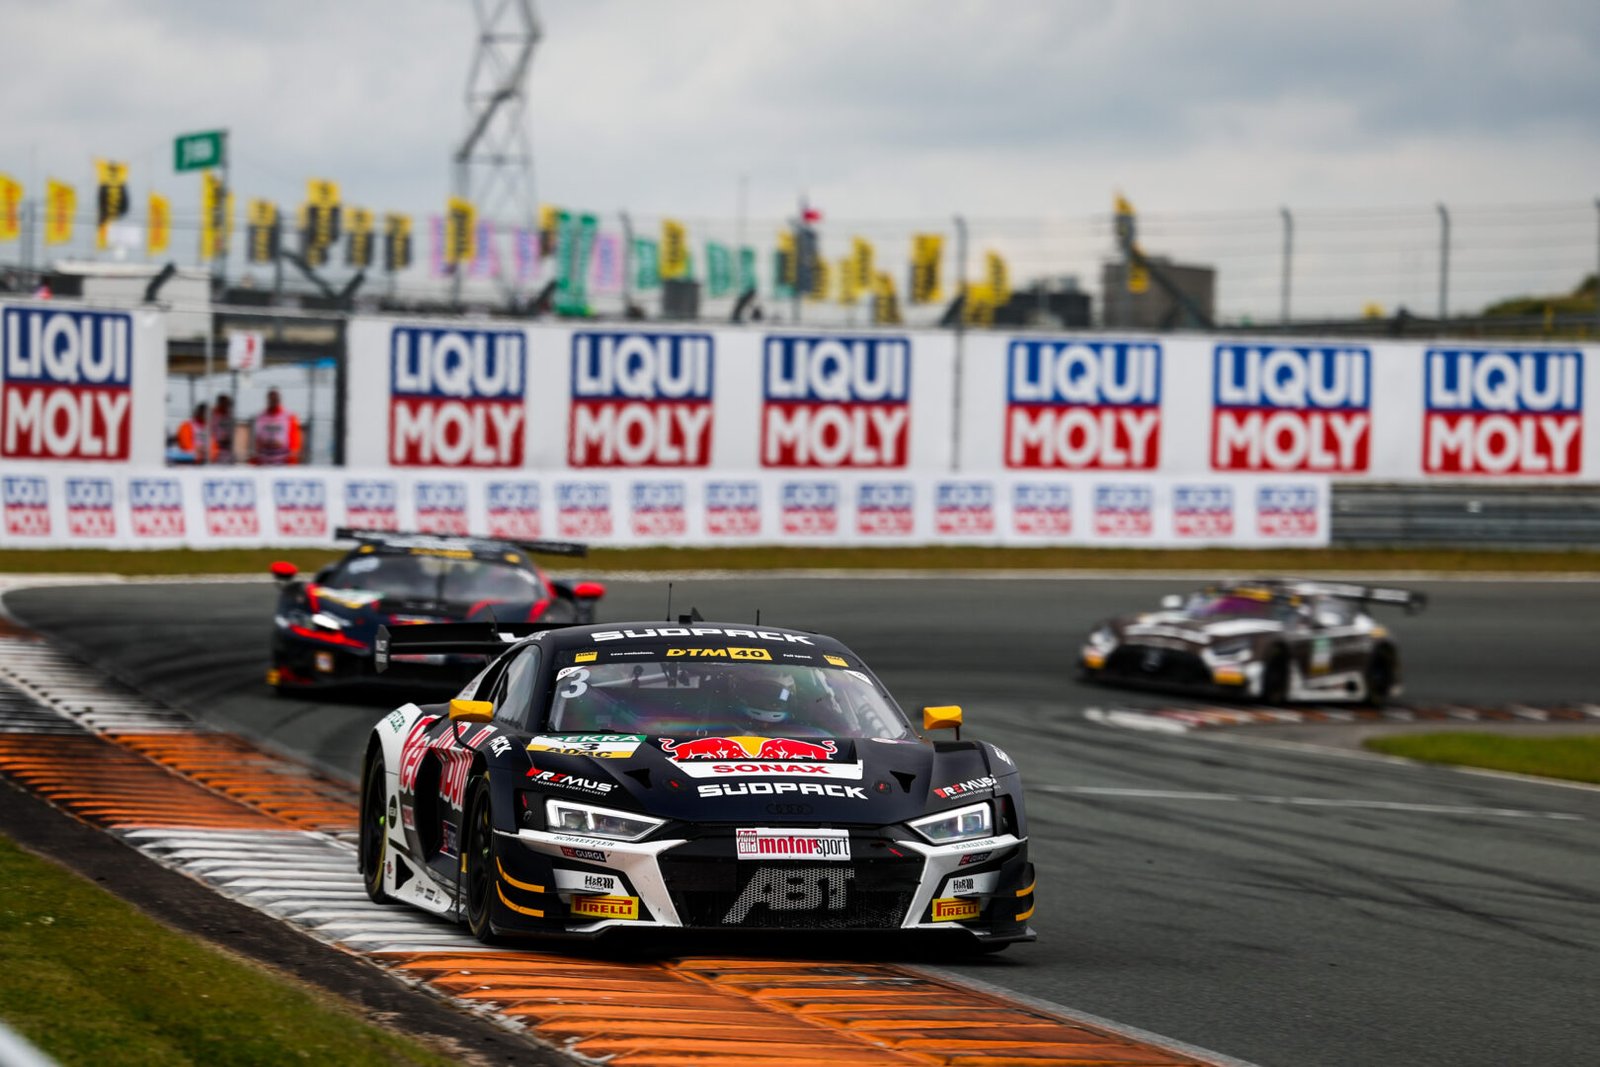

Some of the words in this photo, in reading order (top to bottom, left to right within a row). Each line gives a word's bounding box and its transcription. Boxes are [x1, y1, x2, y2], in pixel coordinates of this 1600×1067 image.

[7, 312, 128, 384] LIQUI
[396, 330, 521, 397] LIQUI
[577, 335, 707, 399] LIQUI
[768, 338, 905, 401] LIQUI
[1013, 344, 1157, 405] LIQUI
[1220, 348, 1365, 408] LIQUI
[1431, 352, 1577, 411] LIQUI
[4, 389, 130, 457] MOLY
[395, 402, 522, 465] MOLY
[574, 404, 710, 465] MOLY
[765, 404, 908, 465] MOLY
[1011, 408, 1159, 467] MOLY
[1216, 410, 1368, 469] MOLY
[1428, 415, 1580, 472] MOLY
[666, 649, 727, 657] DTM
[735, 650, 764, 658] 40
[560, 669, 590, 698] 3
[581, 743, 600, 751] 3
[713, 764, 830, 774] SONAX
[536, 771, 612, 793] REMUS
[574, 896, 633, 915] PIRELLI
[722, 867, 855, 924] ABT
[936, 900, 977, 917] PIRELLI
